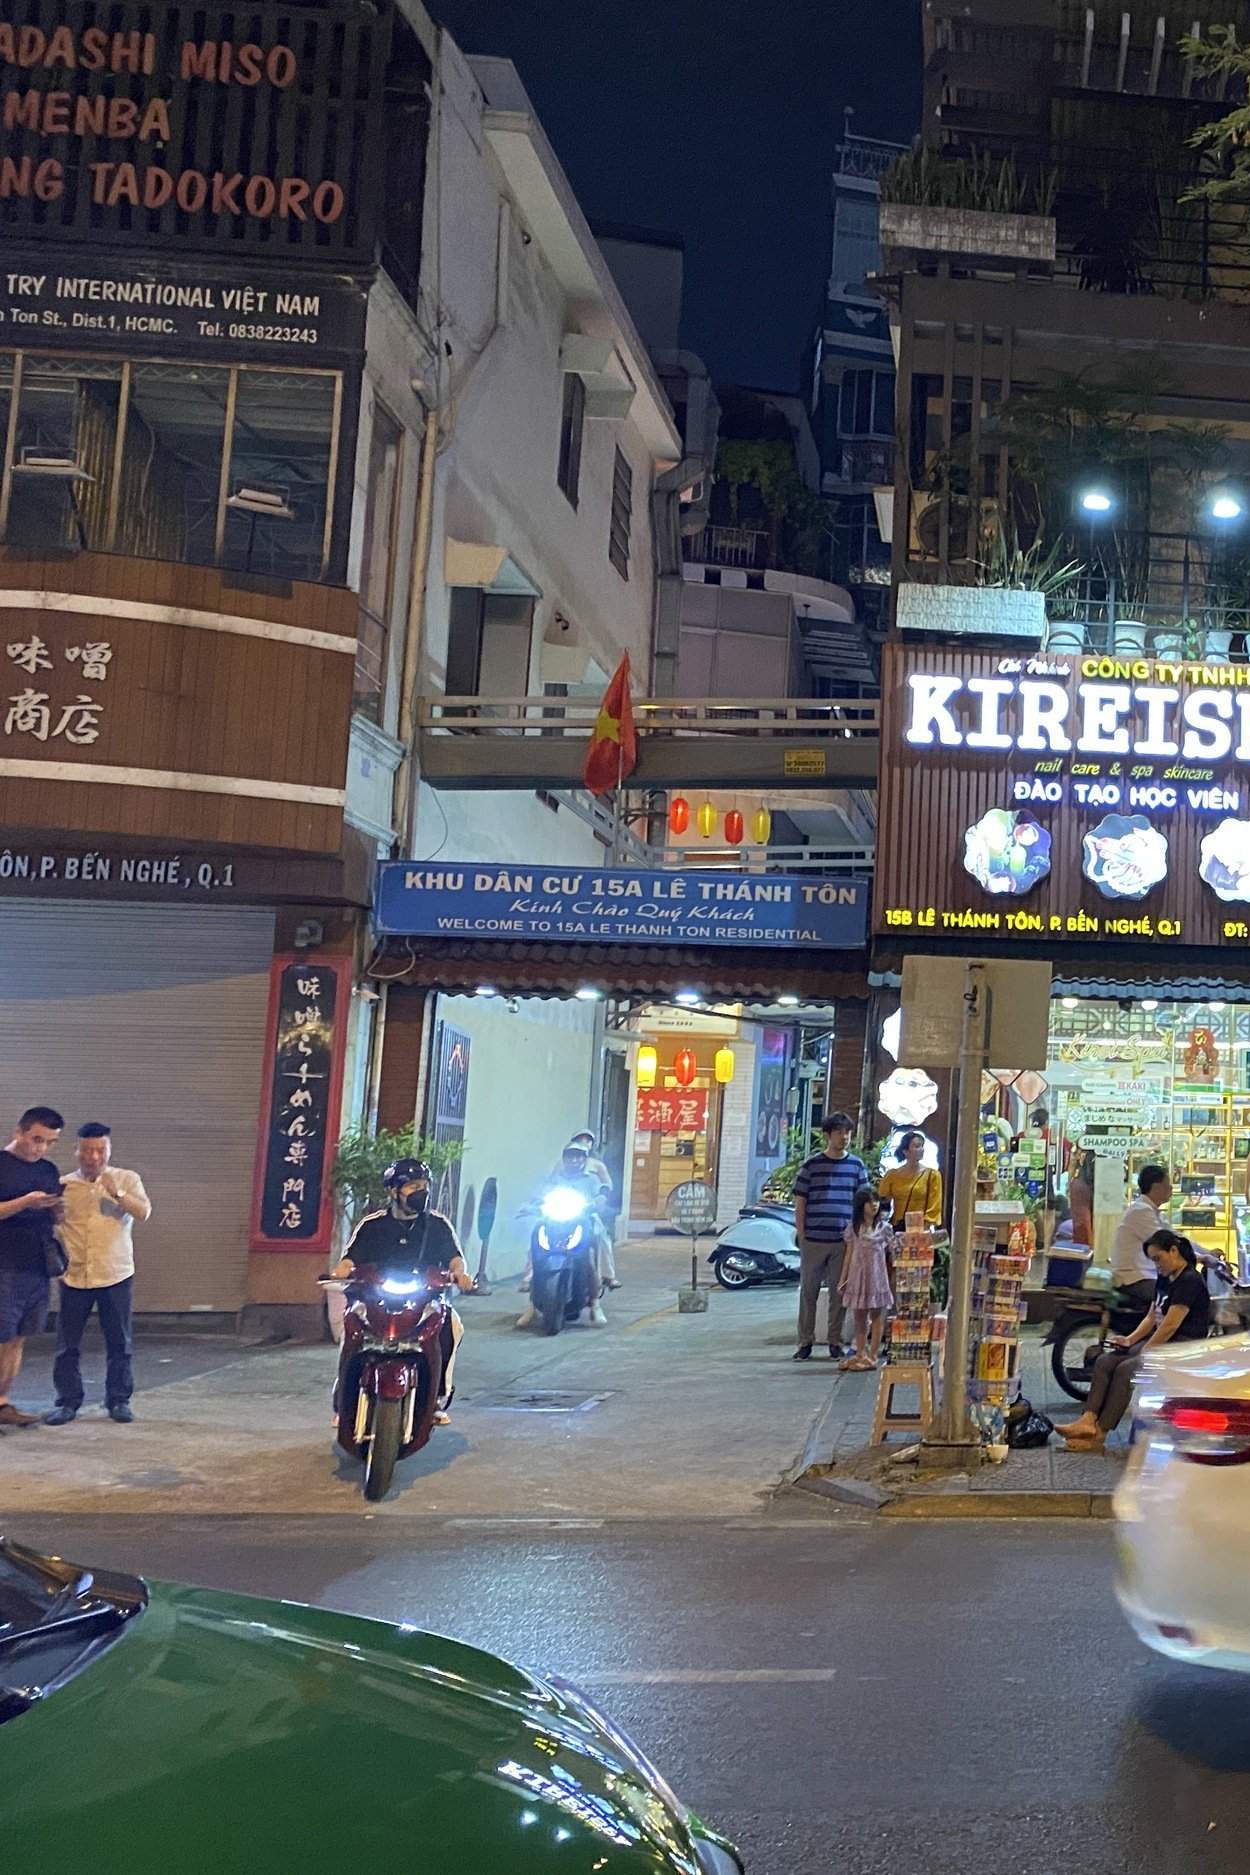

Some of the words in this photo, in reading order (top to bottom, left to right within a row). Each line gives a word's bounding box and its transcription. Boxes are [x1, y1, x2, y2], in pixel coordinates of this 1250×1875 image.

[181, 40, 297, 88] MISO
[3, 89, 170, 141] MENBA
[0, 156, 64, 200] NG
[90, 162, 344, 224] TADOKORO
[7, 274, 46, 295] TRY
[56, 277, 215, 308] INTERNATIONAL
[222, 286, 268, 315] VIỆT
[276, 294, 320, 316] NAM
[11, 308, 38, 323] Ton
[42, 310, 67, 327] St.,
[125, 316, 178, 333] HCMC.
[198, 321, 224, 337] Tel:
[229, 323, 318, 343] 0838223243
[1082, 657, 1150, 682] CÔNG
[1155, 664, 1183, 684] TY
[4, 688, 105, 744] 商店
[1035, 758, 1062, 775] nail
[1071, 763, 1100, 775] care
[1109, 763, 1121, 776] &
[1131, 764, 1153, 779] spa
[1164, 766, 1213, 781] skincare
[1014, 778, 1062, 801] ĐÀO
[1074, 783, 1120, 807] TẠO
[1130, 785, 1177, 809] HỌC
[1187, 785, 1239, 811] VIÊN
[65, 852, 111, 881] BẾN
[199, 865, 234, 889] Q.1
[405, 871, 464, 891] KHU
[474, 869, 534, 893] DÂN
[542, 875, 584, 896] CƯ
[592, 878, 643, 897] 15A
[653, 878, 687, 900] LÊ
[698, 880, 793, 904] THÁNH
[802, 883, 858, 905] TÔN
[509, 898, 563, 914] Kính
[572, 900, 630, 917] Chào
[636, 903, 683, 921] Quý
[687, 904, 756, 922] Khách
[886, 909, 911, 926] 15B
[918, 909, 935, 928] LÊ
[942, 909, 999, 930] THÁNH
[1005, 912, 1044, 933] TÔN,
[1050, 915, 1062, 931] P.
[1067, 912, 1098, 933] BẾN
[1105, 914, 1154, 937] NGHÉ,
[1158, 919, 1181, 936] Q.1
[1224, 922, 1248, 938] ĐT:
[437, 917, 525, 931] WELCOME
[529, 920, 551, 932] TO
[557, 922, 586, 933] 15A
[590, 923, 611, 934] LE
[615, 923, 672, 936] THANH
[677, 926, 711, 937] TON
[715, 927, 822, 941] RESIDENTIAL
[1066, 1032, 1119, 1059] Kirei
[1084, 1138, 1127, 1147] SHAMPOO
[1129, 1139, 1145, 1147] SPA
